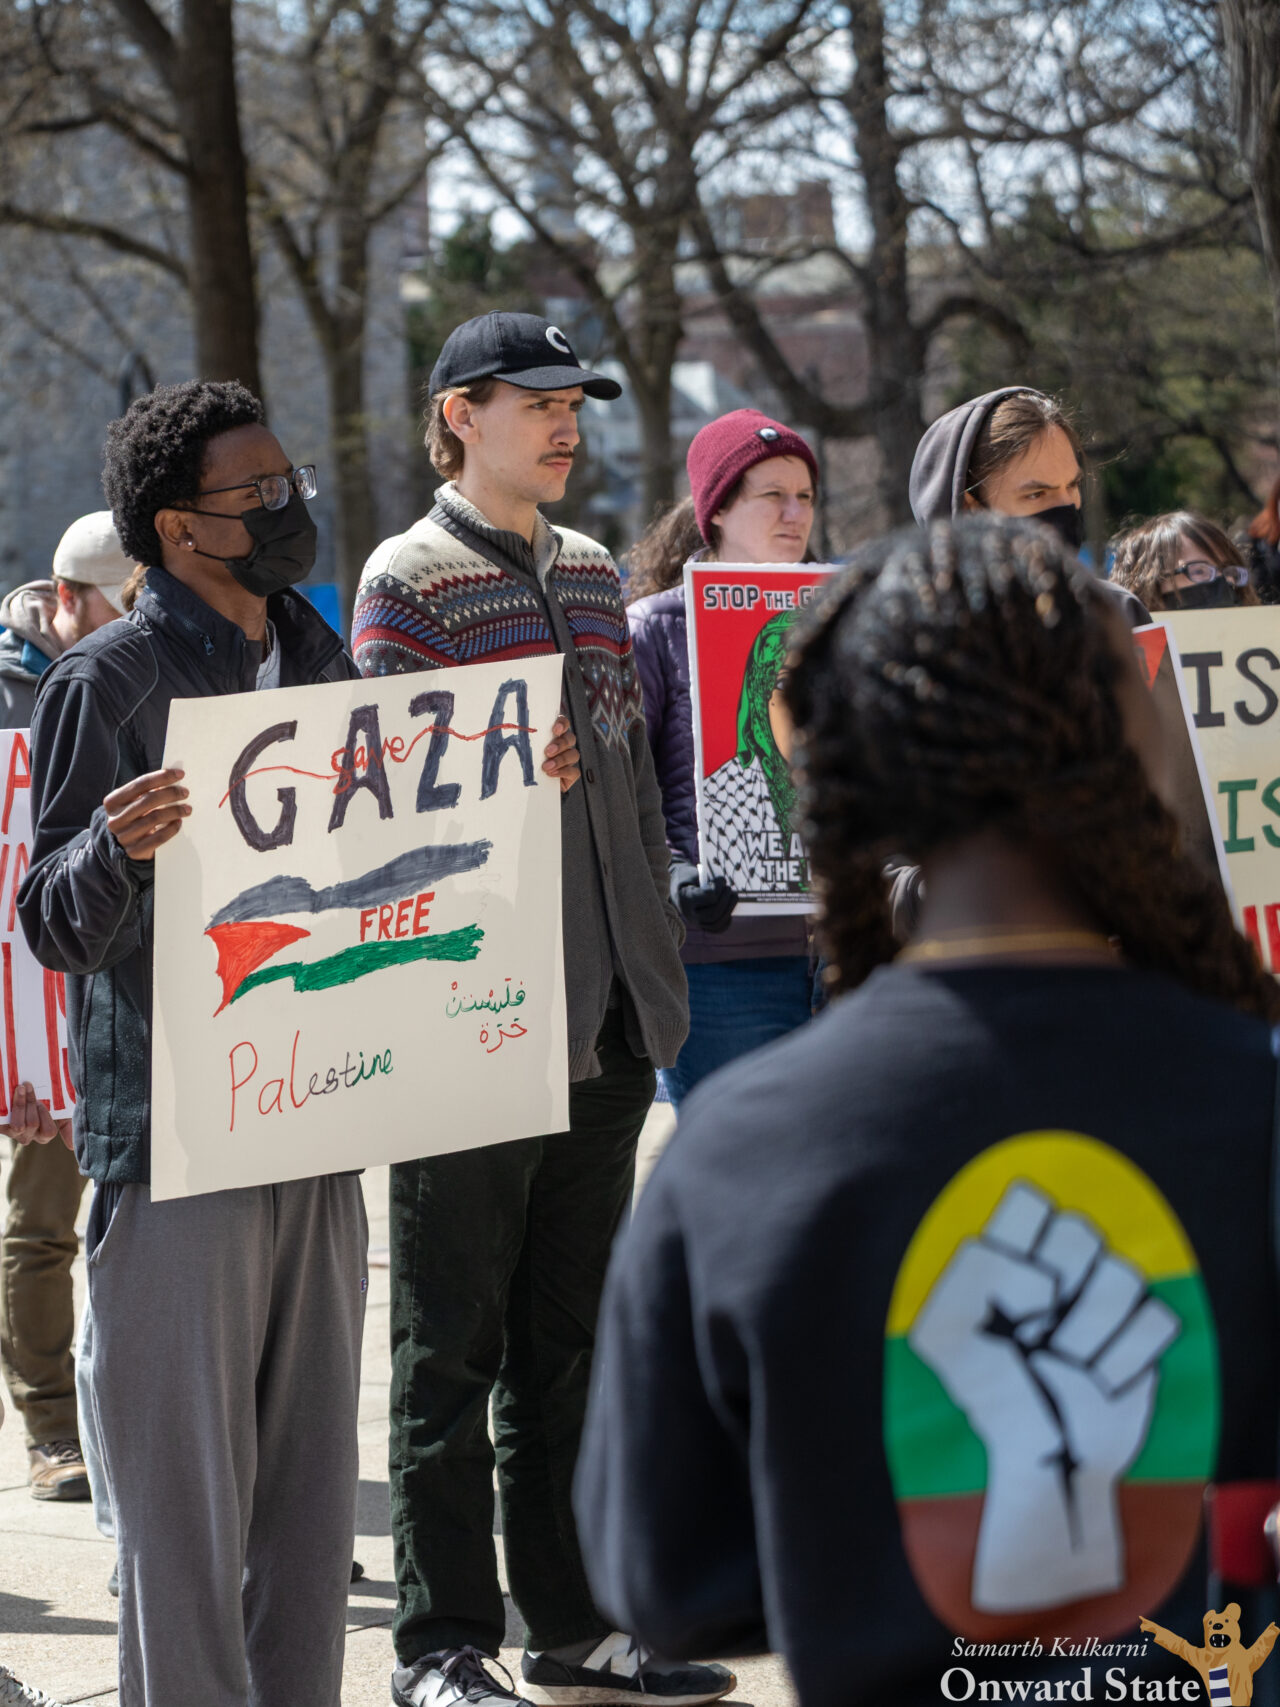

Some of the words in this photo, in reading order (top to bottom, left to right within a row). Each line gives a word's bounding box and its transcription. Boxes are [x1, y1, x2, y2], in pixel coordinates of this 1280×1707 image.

[704, 584, 760, 610] STOP
[763, 591, 795, 610] THE
[229, 678, 538, 852] GAZA
[745, 832, 783, 859] WE
[762, 860, 801, 882] THE
[360, 891, 436, 943] FREE
[229, 1030, 393, 1132] Palestine
